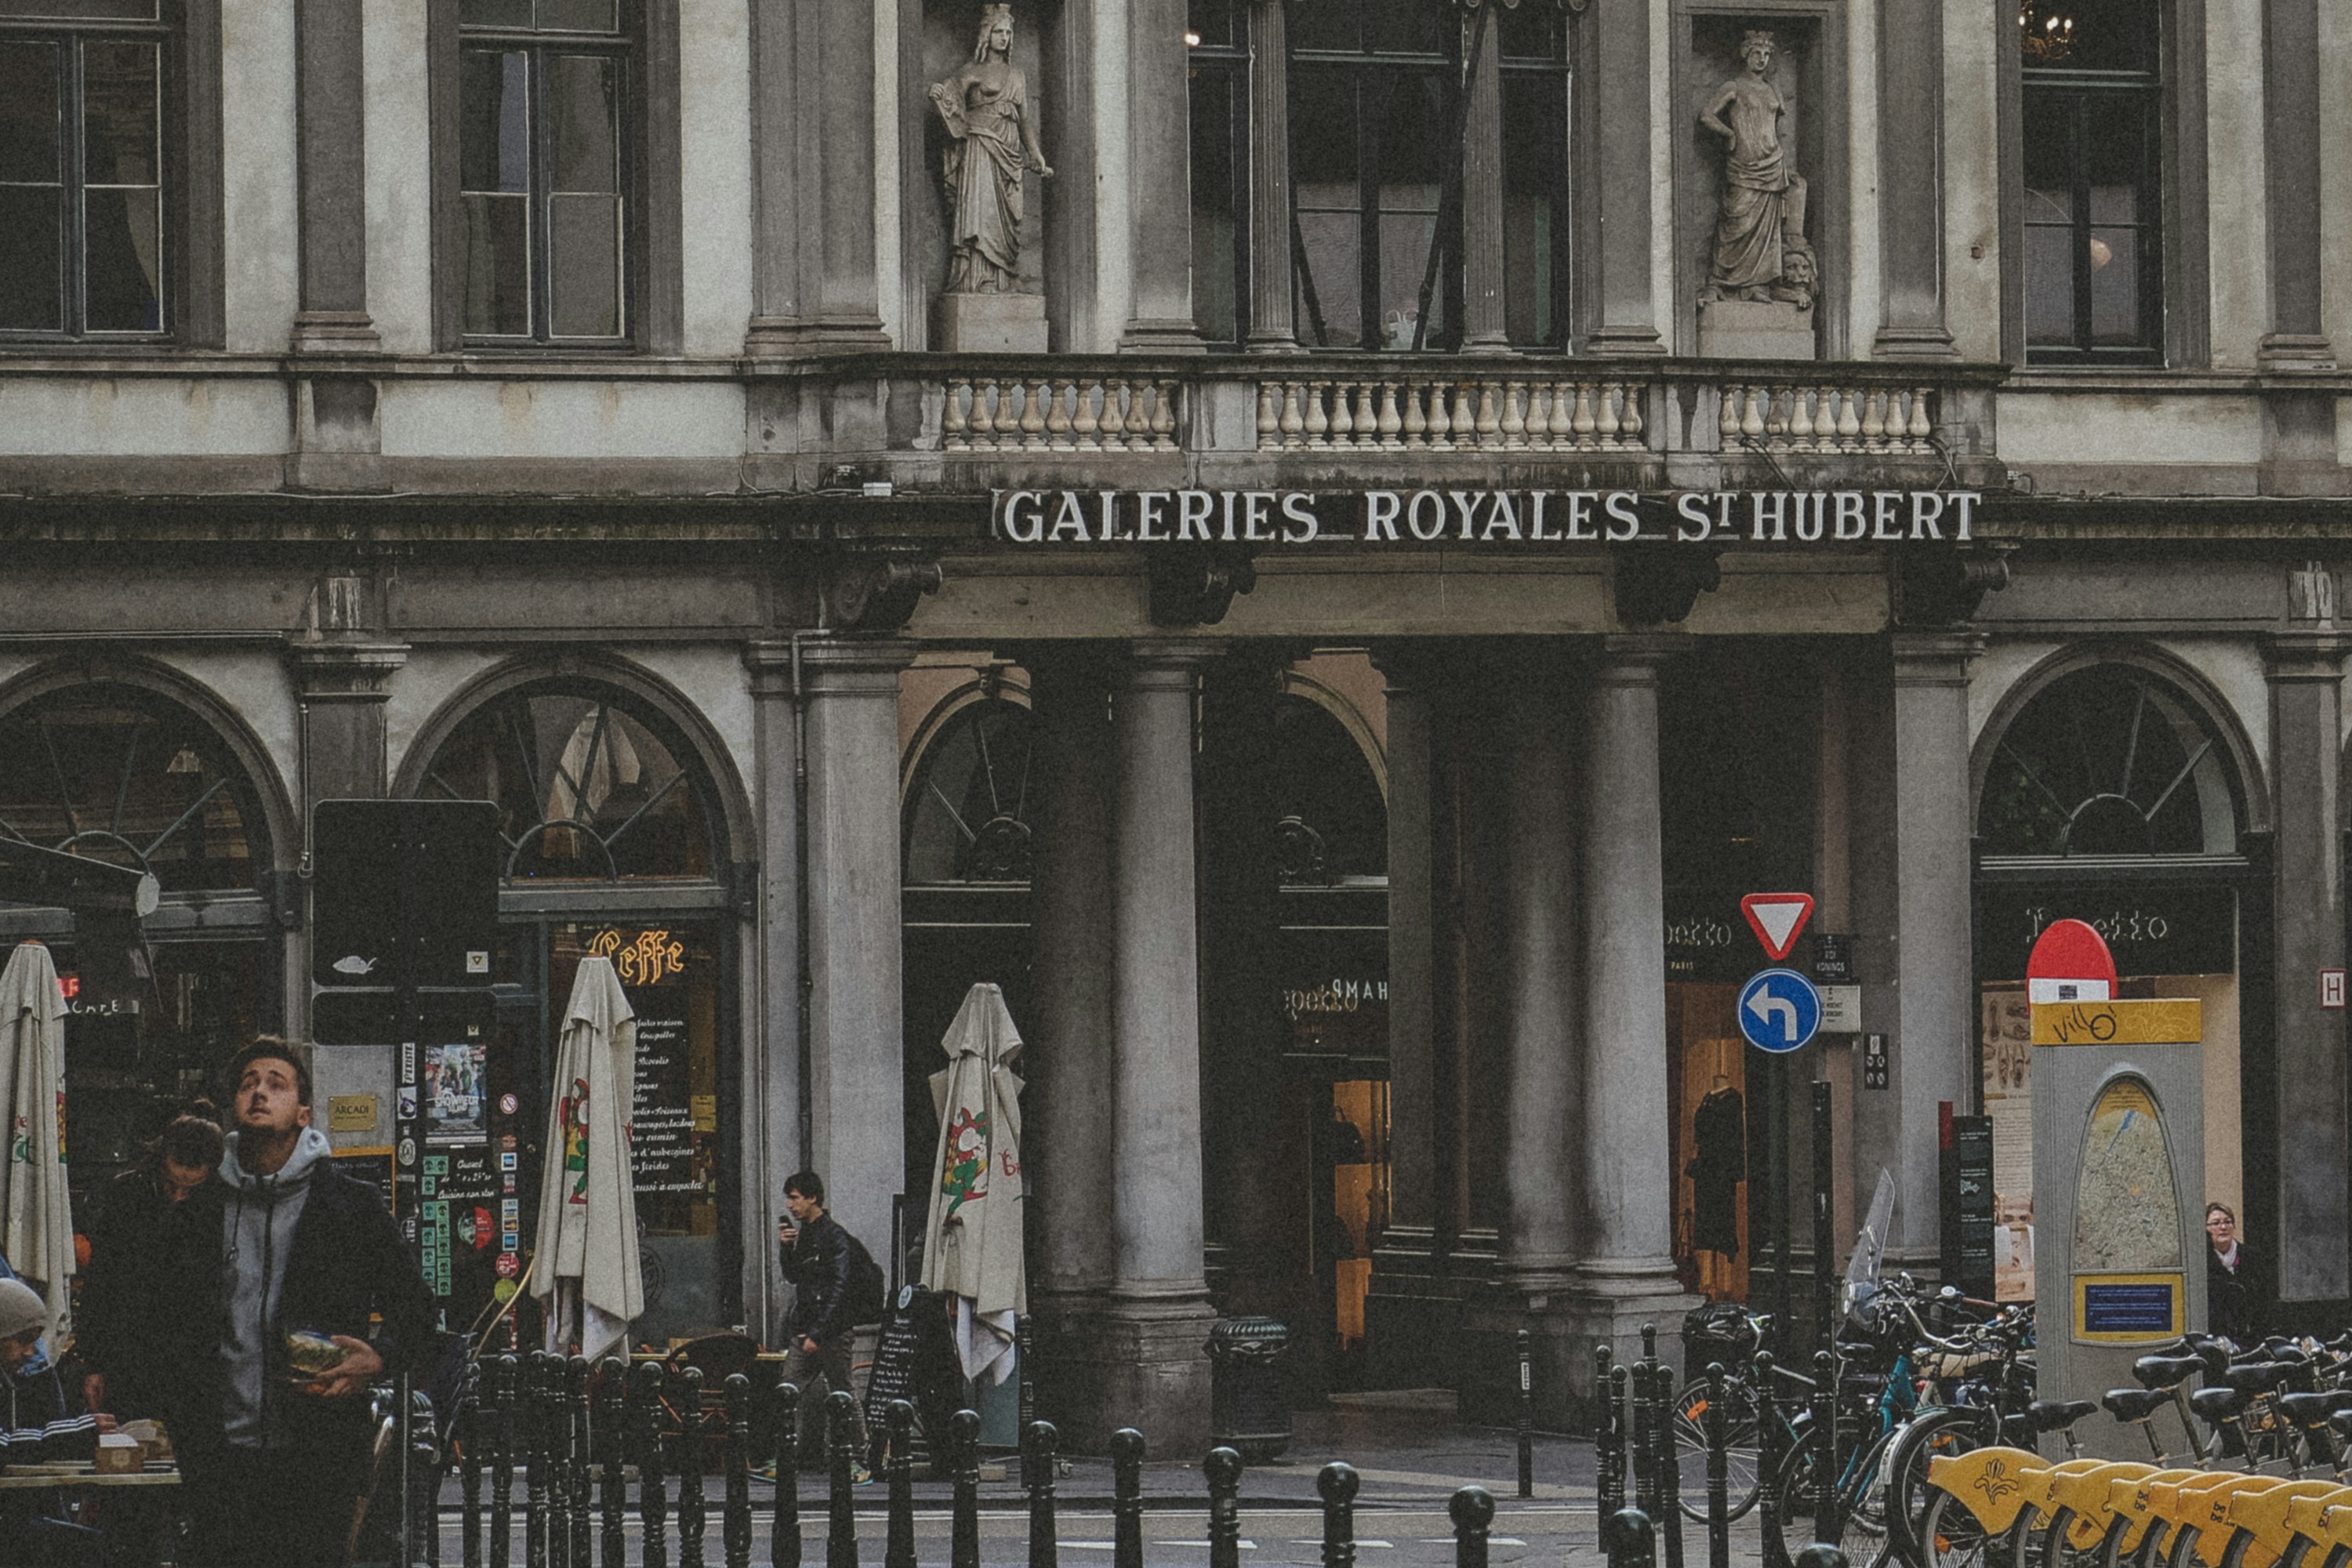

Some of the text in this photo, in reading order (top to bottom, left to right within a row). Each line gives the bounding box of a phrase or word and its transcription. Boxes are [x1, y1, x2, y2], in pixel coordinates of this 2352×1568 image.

[1004, 490, 1318, 542] GALERIES
[1364, 490, 1639, 541] ROYALES
[1751, 492, 1982, 541] HUBERT
[589, 930, 684, 985] Leffe
[2327, 978, 2340, 1000] H
[335, 1104, 369, 1114] ARCADI
[646, 1131, 677, 1142] cumin
